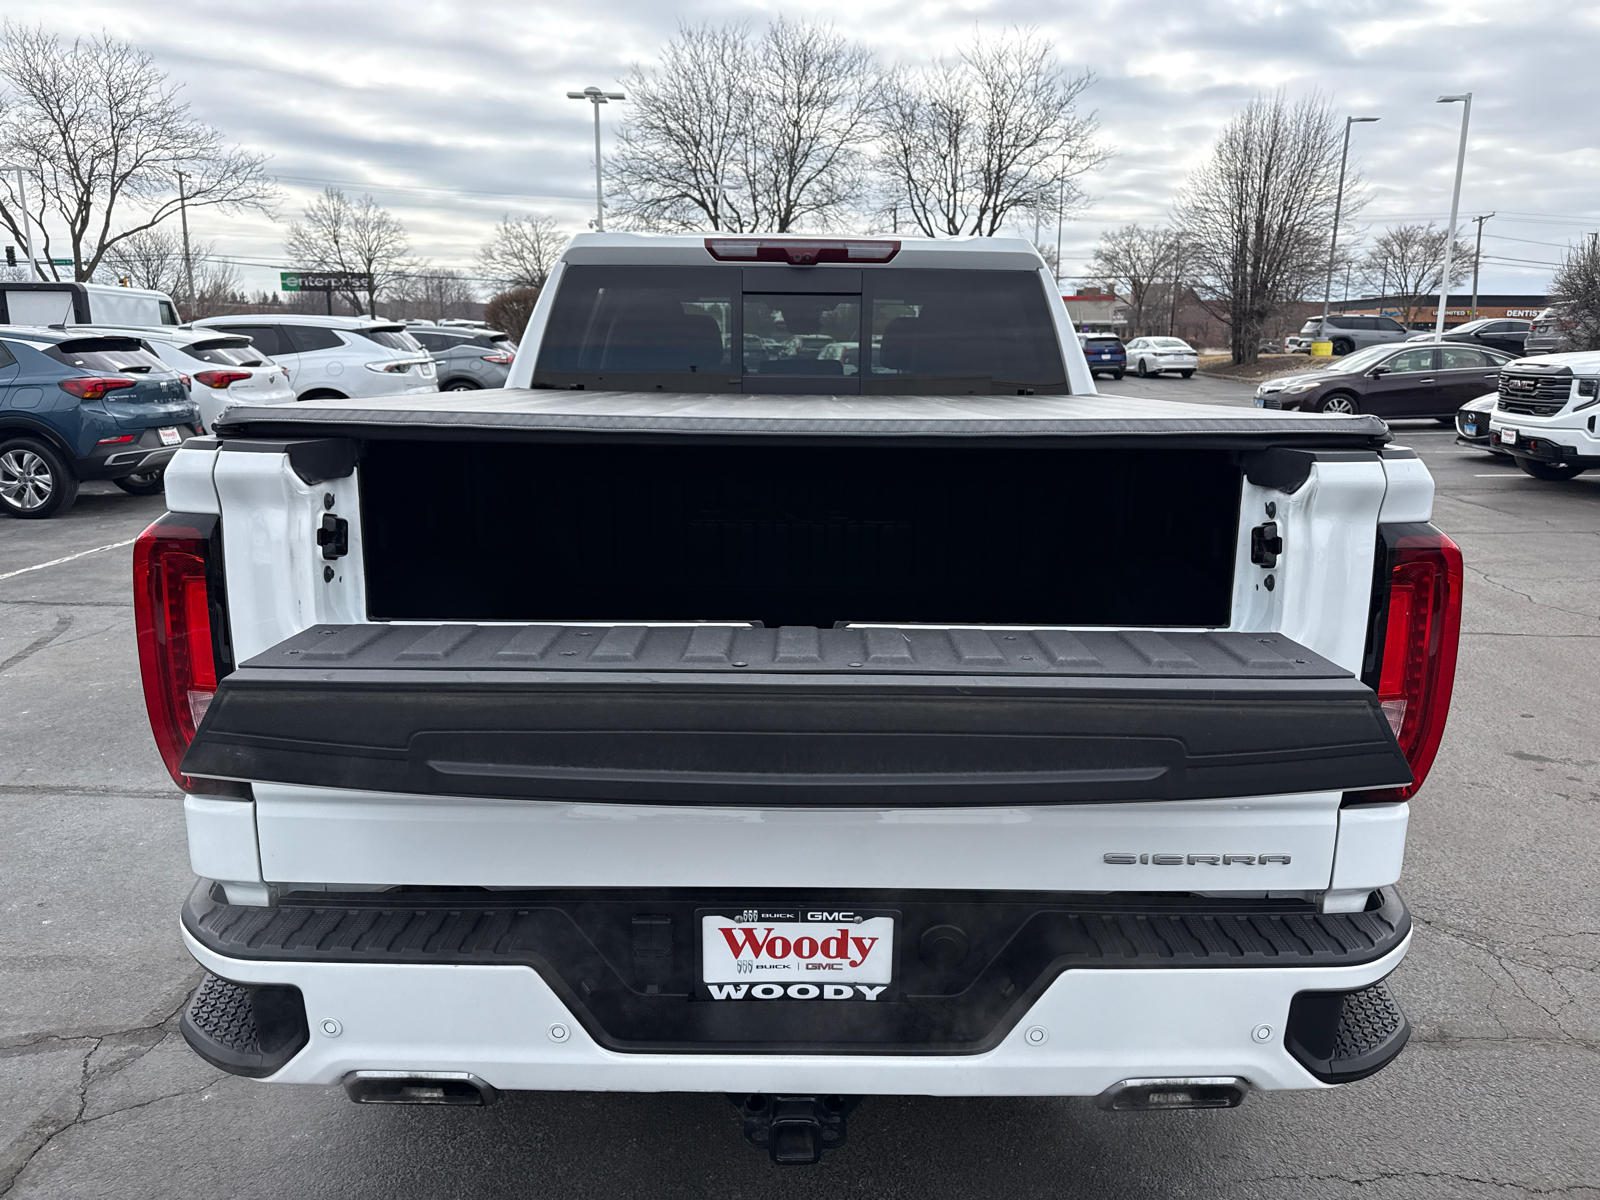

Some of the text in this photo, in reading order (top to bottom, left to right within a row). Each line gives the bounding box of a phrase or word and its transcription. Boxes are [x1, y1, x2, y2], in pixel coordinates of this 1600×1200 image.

[282, 275, 369, 289] enterprise
[1103, 852, 1291, 866] SIERRA
[807, 912, 854, 921] GMC
[718, 927, 879, 968] Woody
[805, 963, 843, 971] GMC
[707, 983, 888, 1001] WOODY
